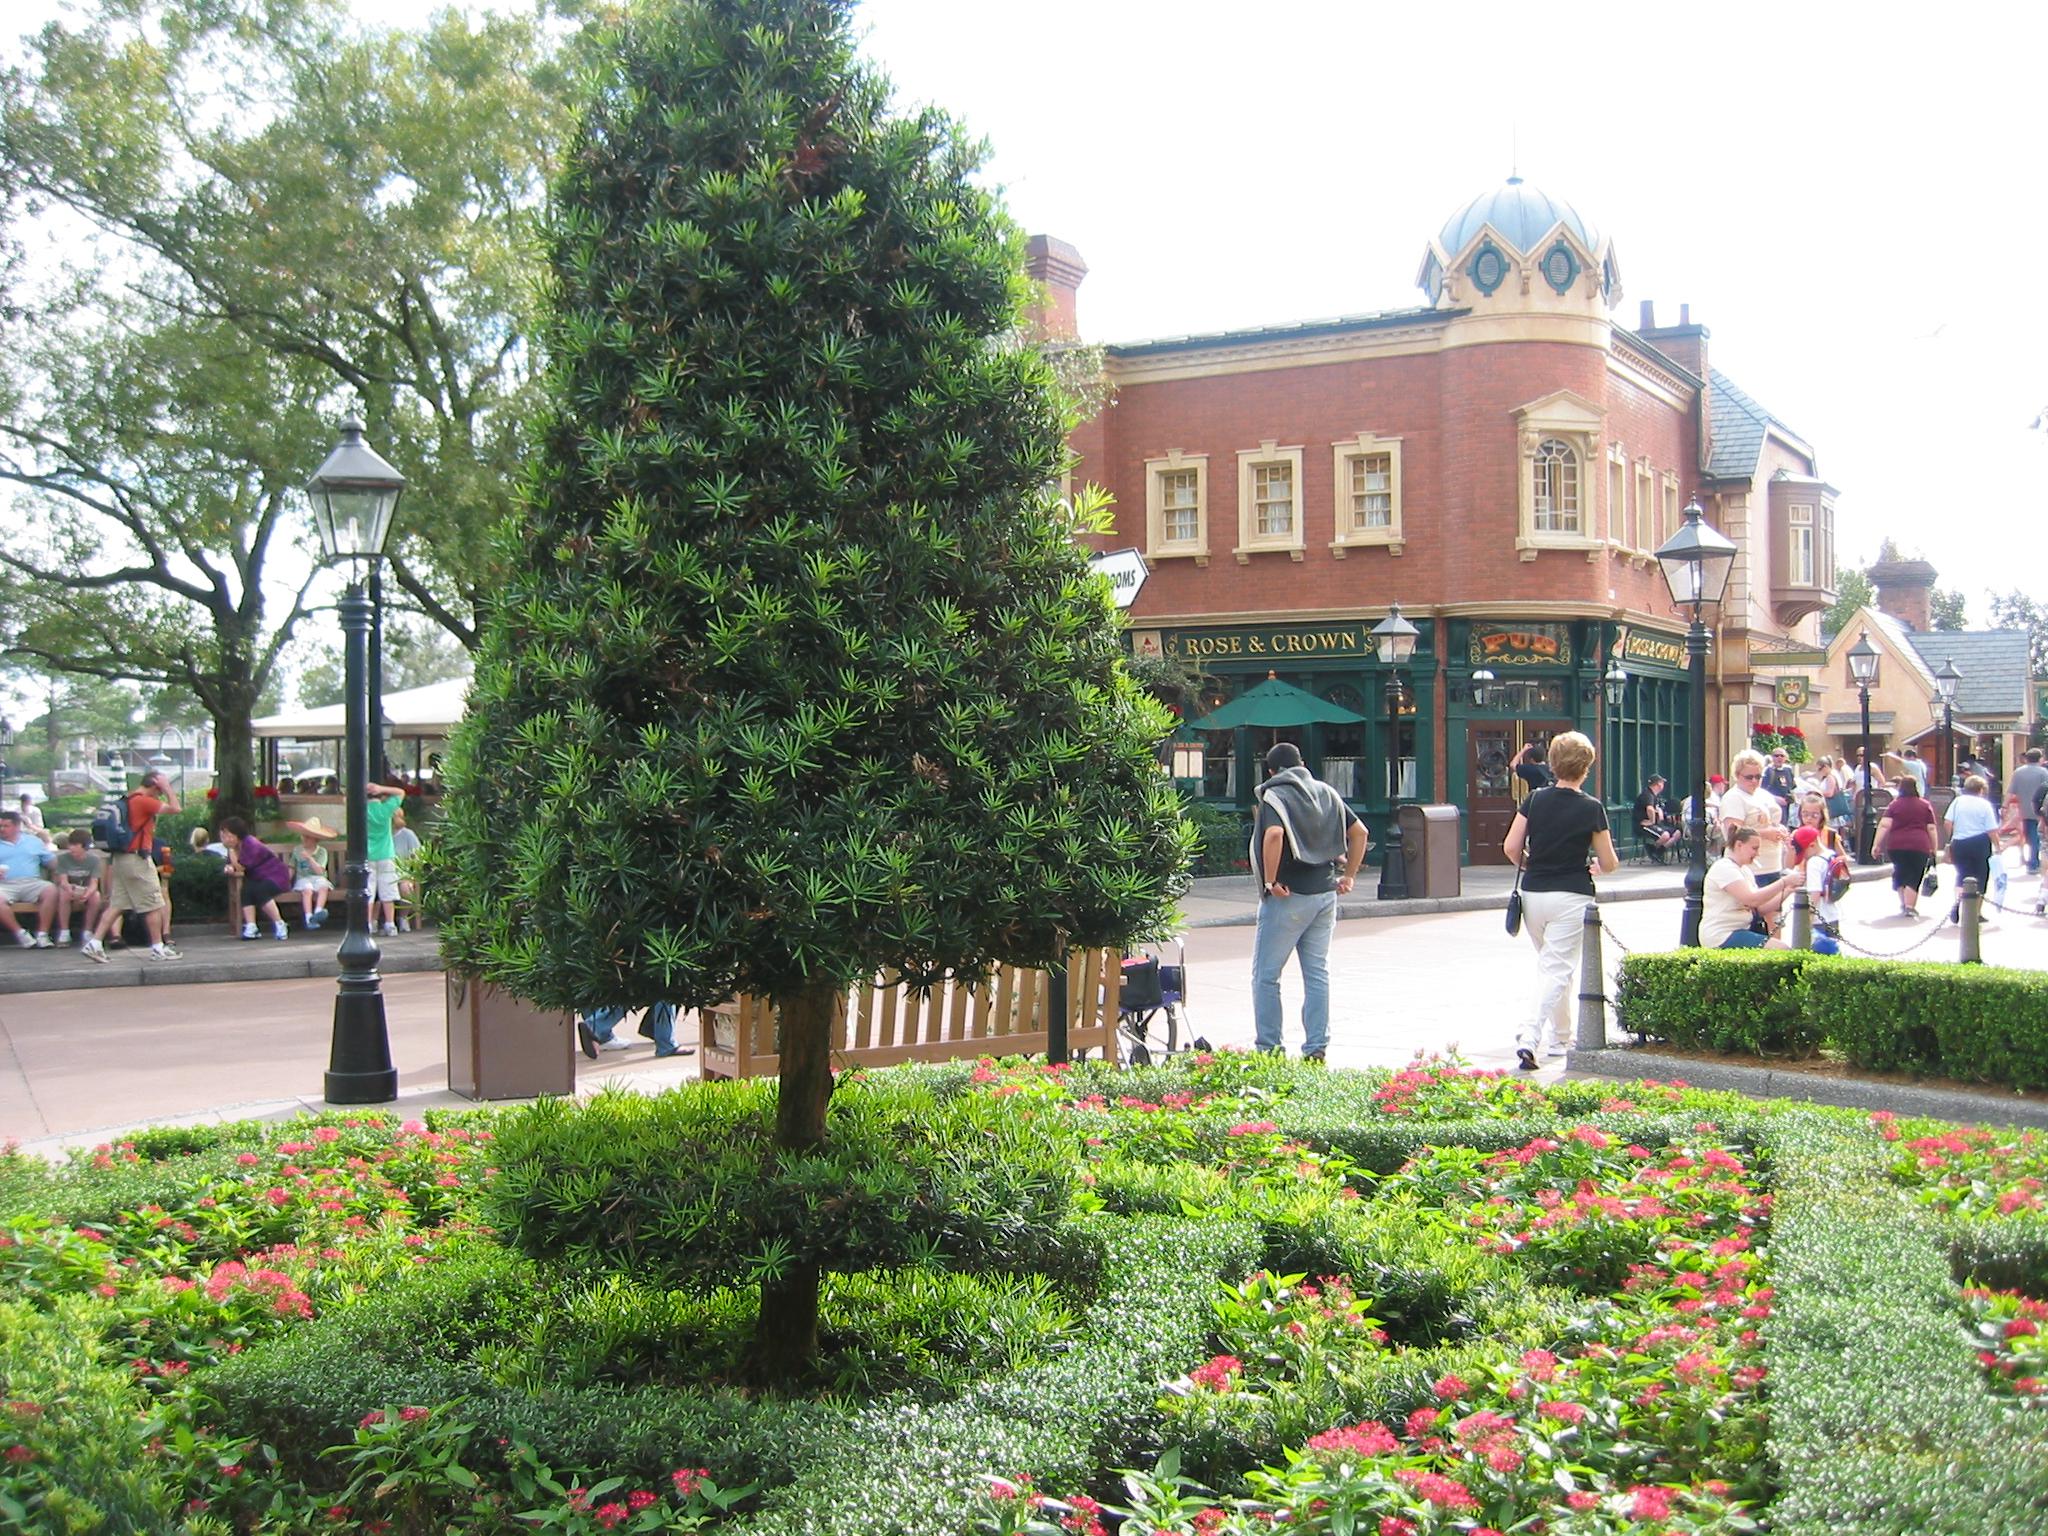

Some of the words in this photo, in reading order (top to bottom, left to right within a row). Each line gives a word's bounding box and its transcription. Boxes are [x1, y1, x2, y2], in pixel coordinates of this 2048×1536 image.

[1185, 636, 1242, 655] ROSE
[1248, 635, 1266, 653] &
[1271, 631, 1357, 653] CROWN
[1481, 632, 1558, 656] PUB
